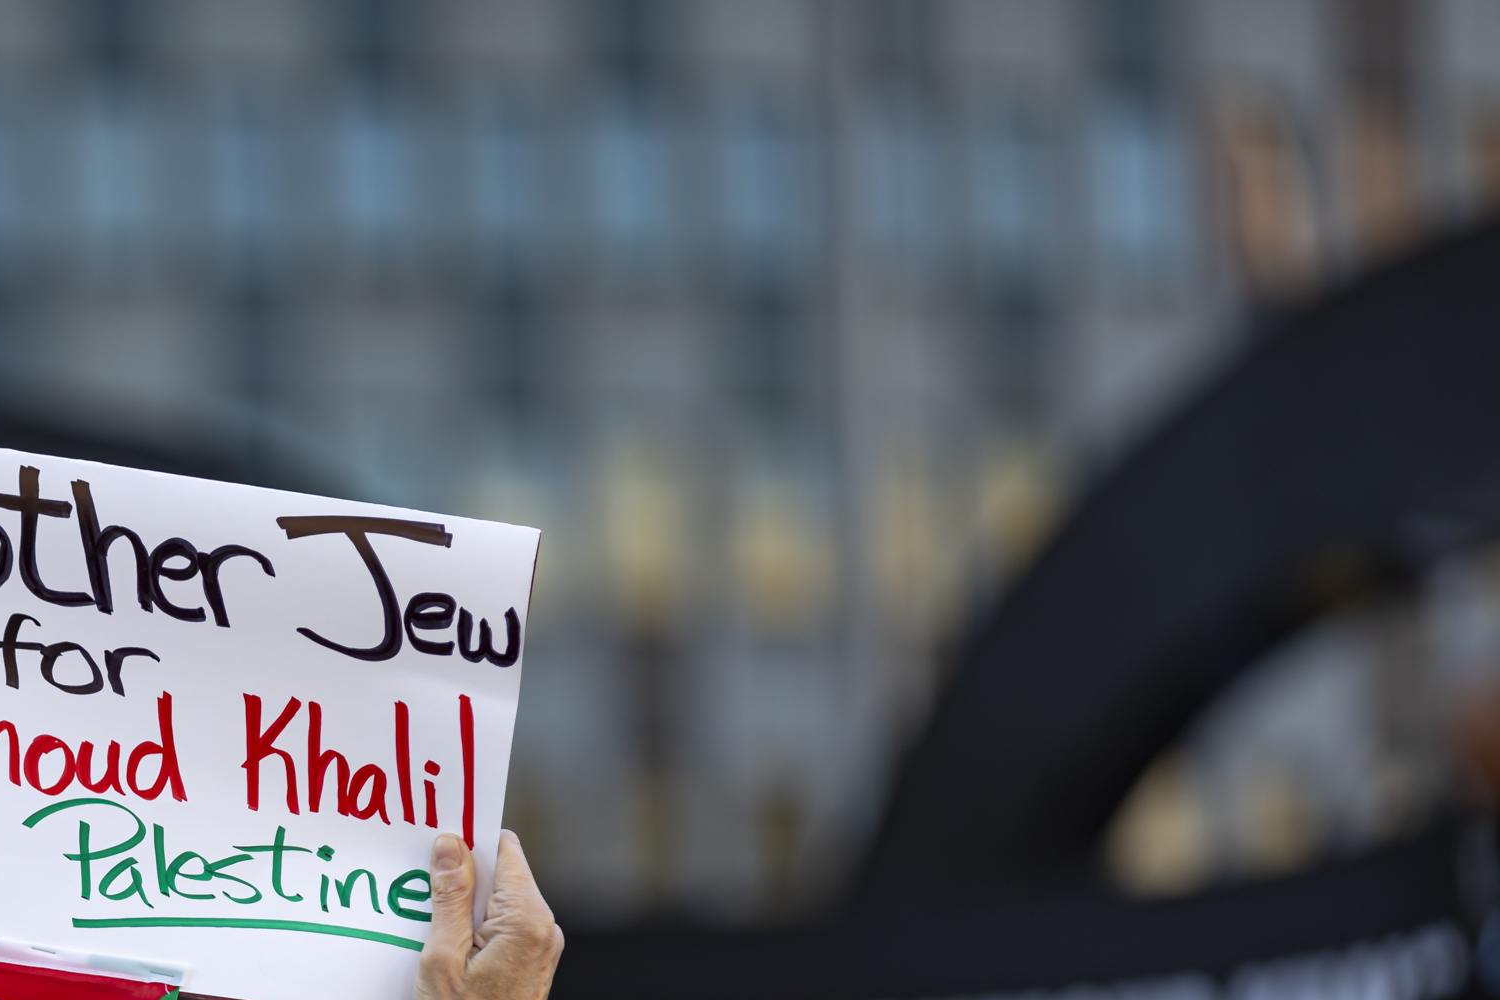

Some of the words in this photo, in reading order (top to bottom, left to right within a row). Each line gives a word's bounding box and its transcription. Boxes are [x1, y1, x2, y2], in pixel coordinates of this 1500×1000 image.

[276, 515, 520, 668] Jew
[242, 693, 475, 850] Khalil
[22, 798, 432, 922] Palestine
